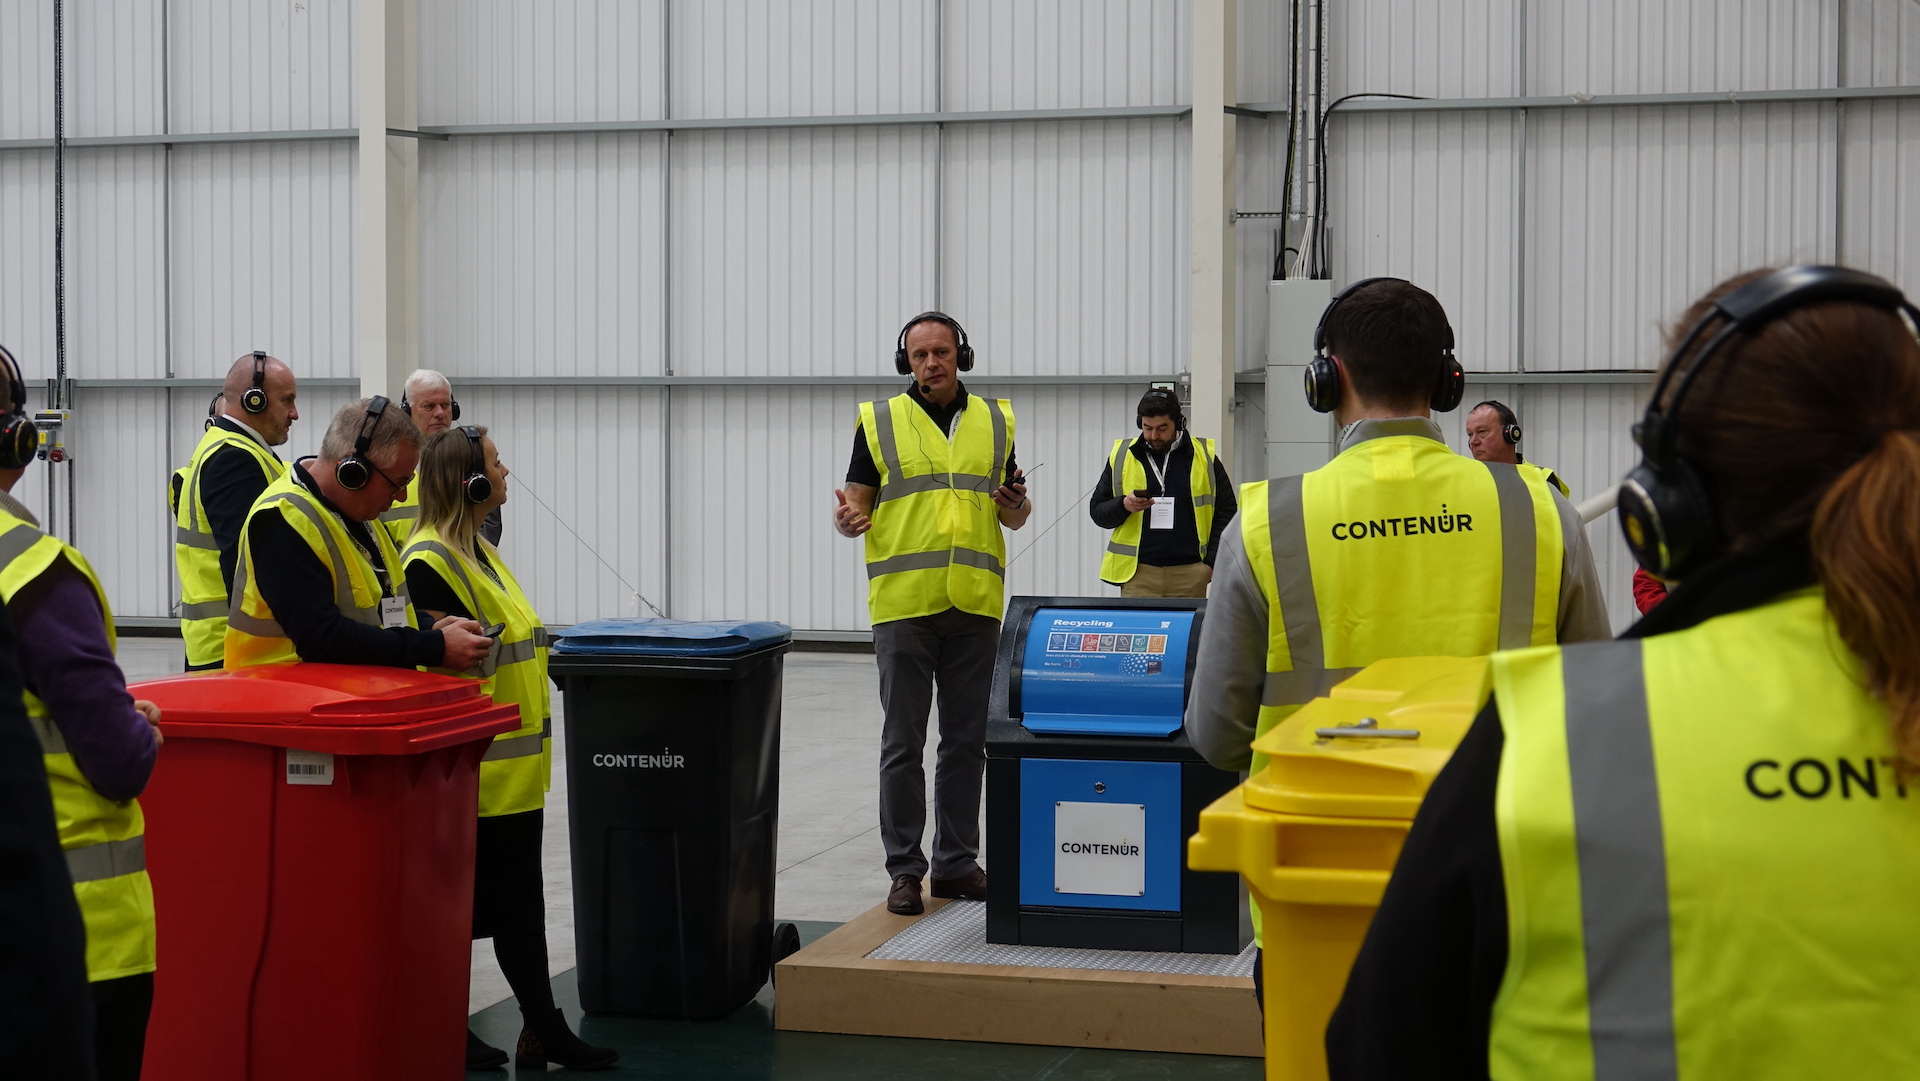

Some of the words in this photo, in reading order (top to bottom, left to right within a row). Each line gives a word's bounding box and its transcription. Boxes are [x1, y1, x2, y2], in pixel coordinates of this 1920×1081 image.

[1331, 503, 1473, 541] CONTENUR
[1053, 619, 1114, 628] Recycling
[593, 747, 684, 768] CONTENUR
[1061, 838, 1139, 856] CONTENUR
